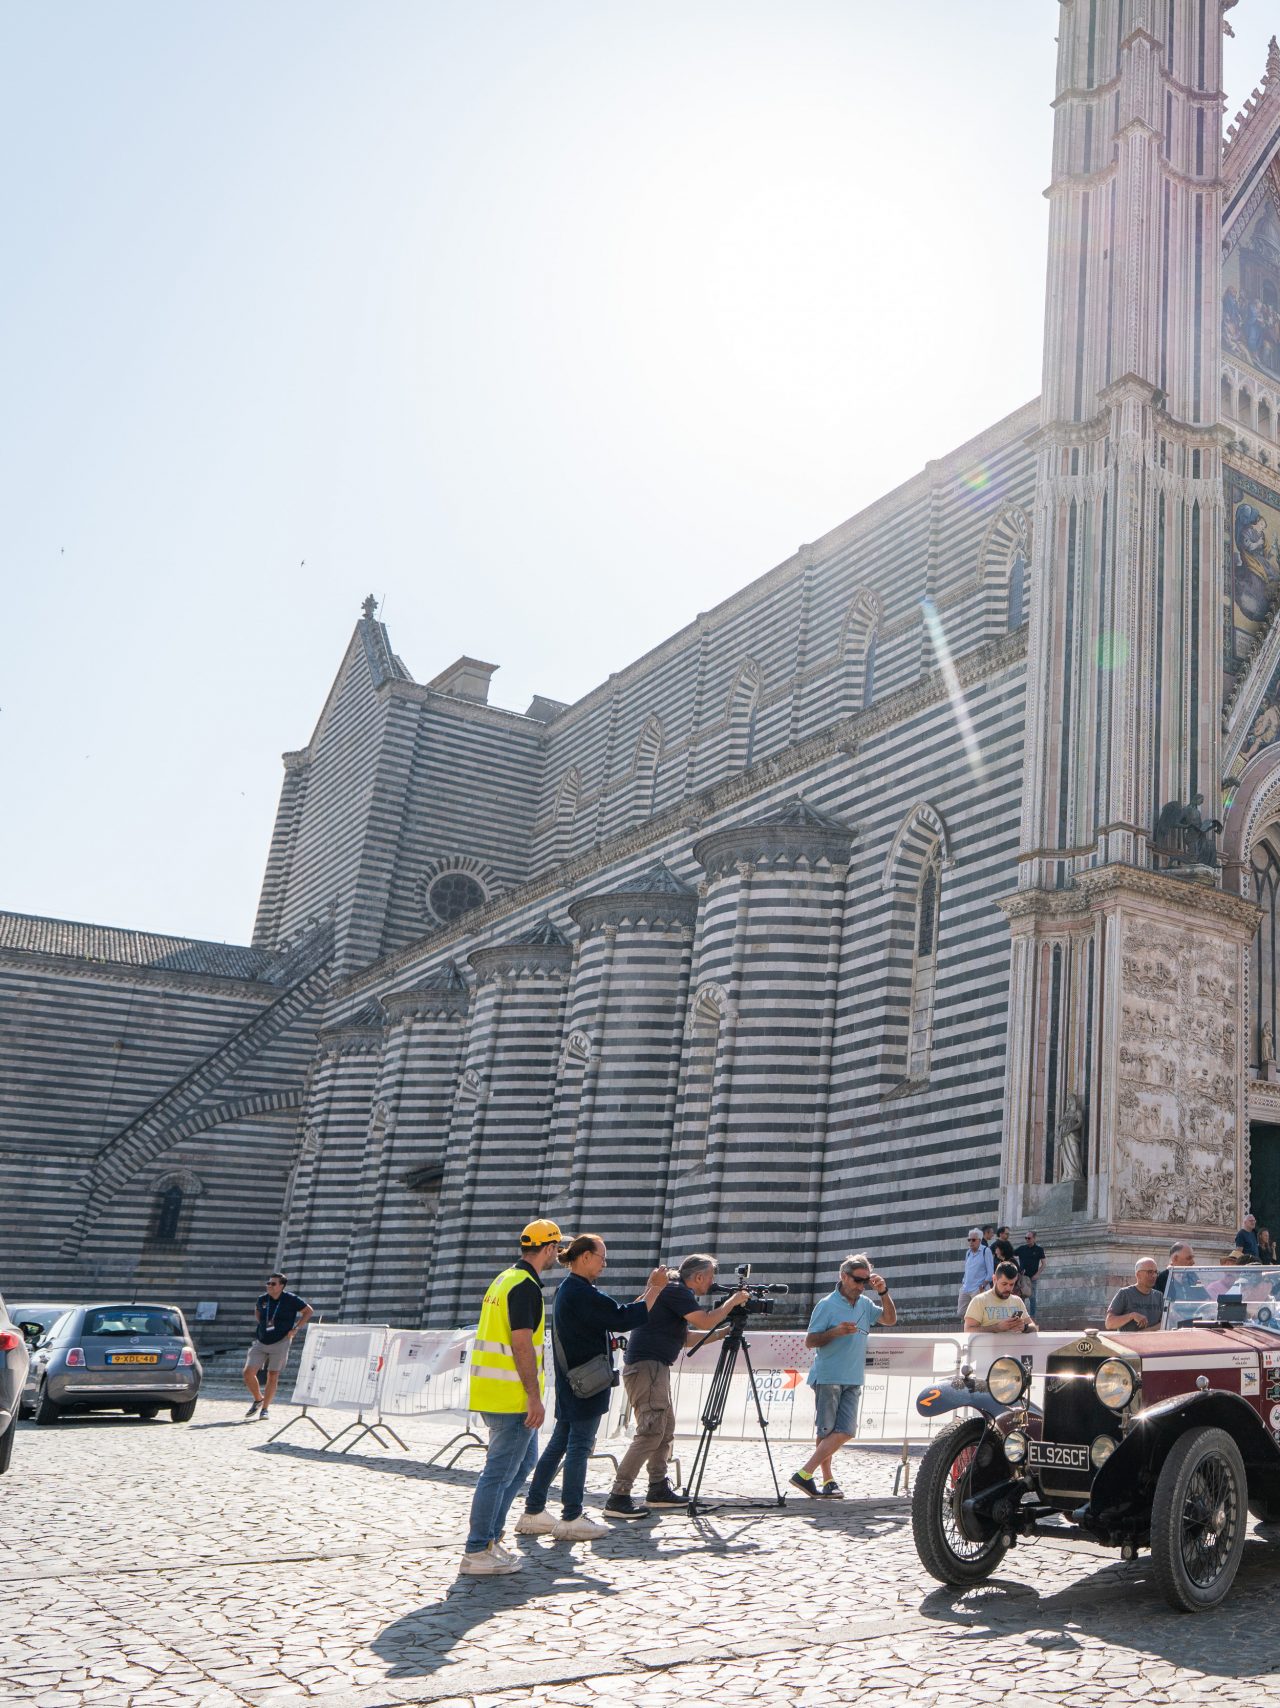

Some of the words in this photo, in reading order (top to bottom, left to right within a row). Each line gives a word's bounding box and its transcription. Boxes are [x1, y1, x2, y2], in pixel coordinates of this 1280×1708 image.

[114, 1354, 155, 1363] 9-XDL-48
[750, 1377, 782, 1389] 000
[919, 1389, 941, 1406] 2
[1029, 1446, 1087, 1466] EL926CF
